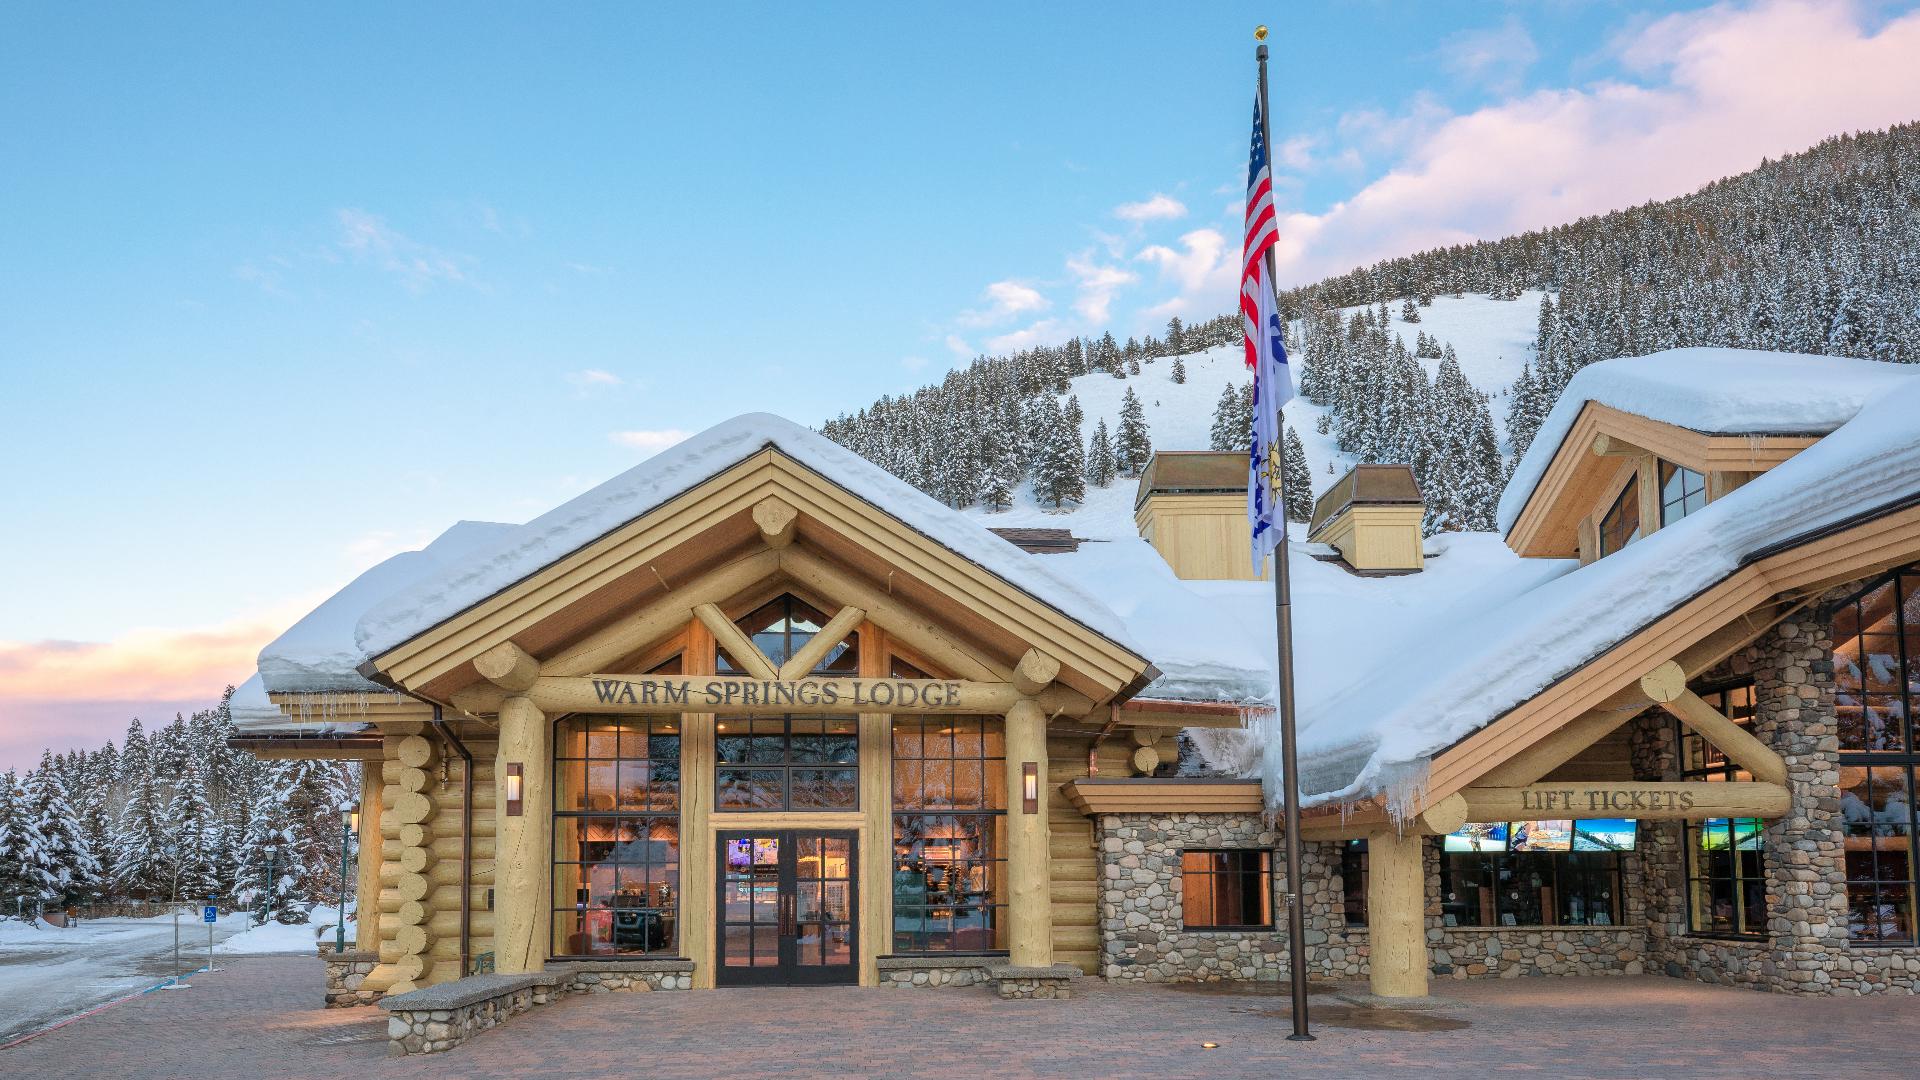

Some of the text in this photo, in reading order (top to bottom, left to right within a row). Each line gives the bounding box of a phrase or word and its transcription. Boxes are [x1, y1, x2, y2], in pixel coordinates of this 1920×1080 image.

[593, 680, 962, 707] WARM SPRINGS LODGE
[1521, 790, 1694, 811] LIFT TICKETS
